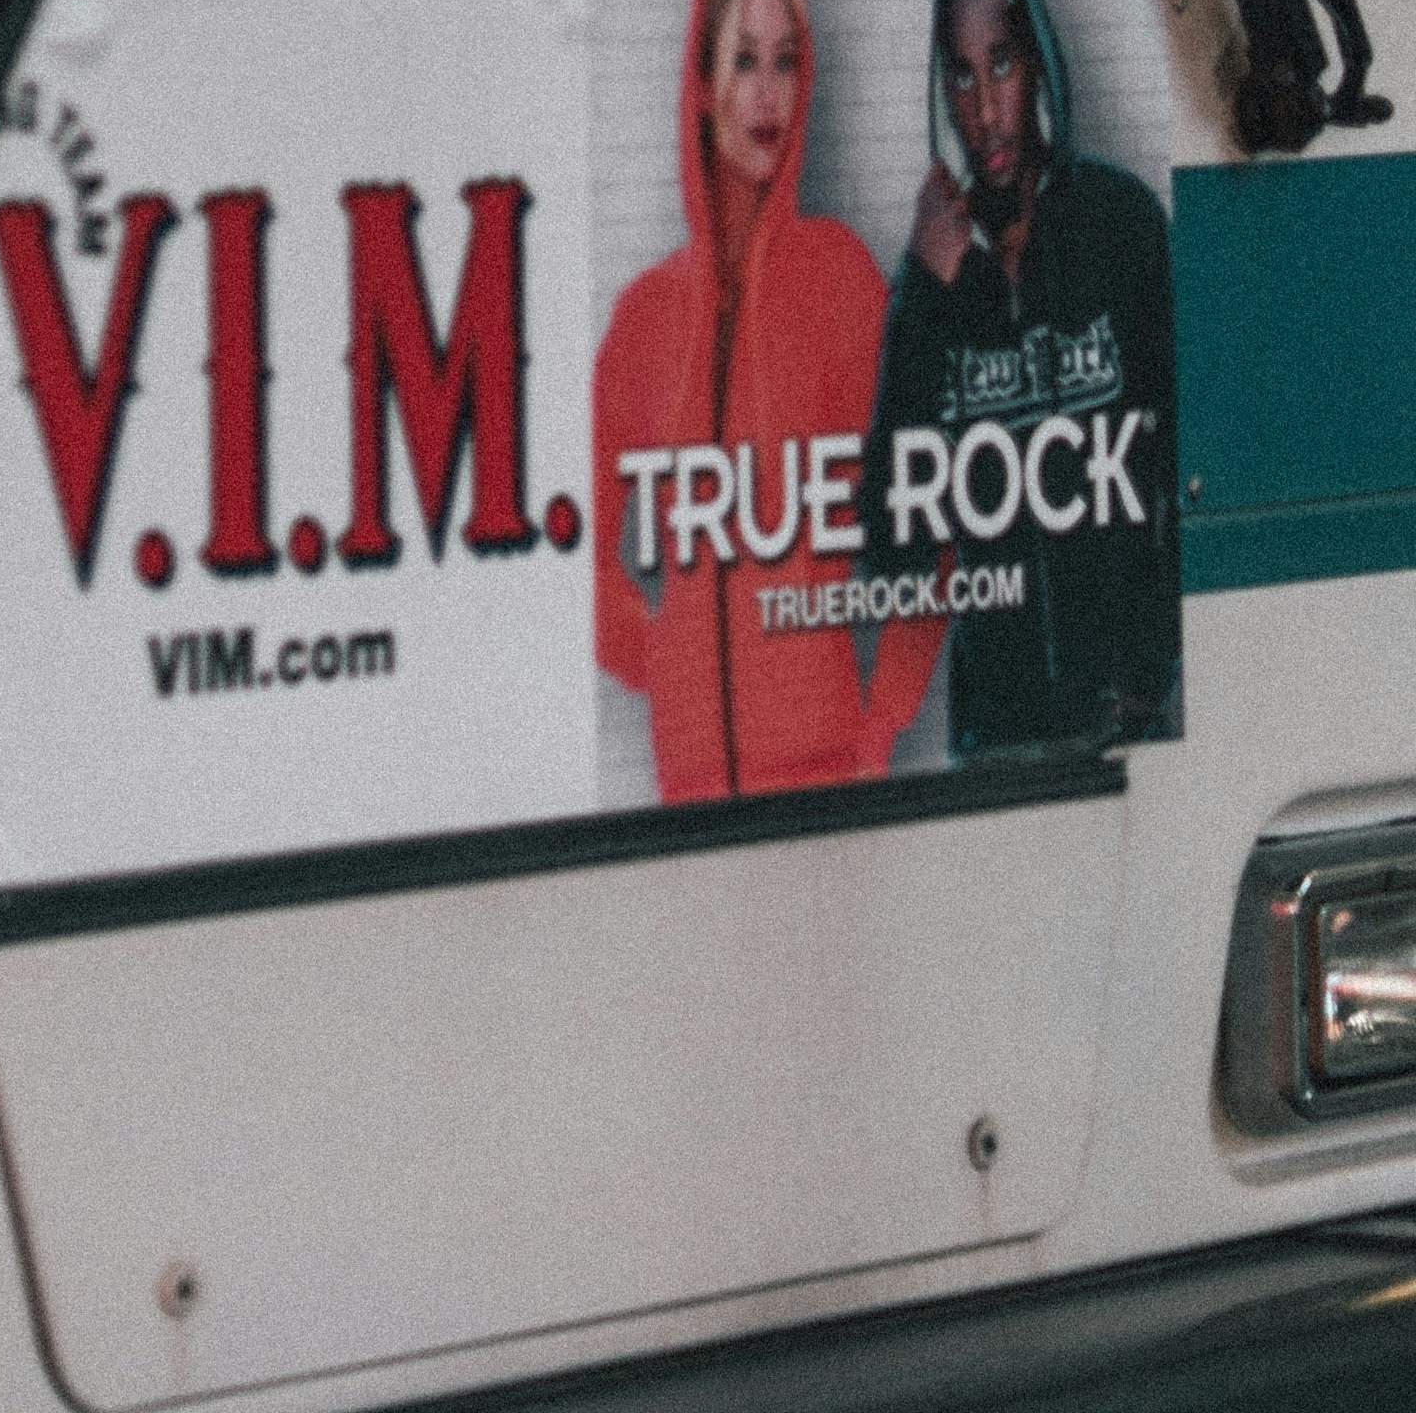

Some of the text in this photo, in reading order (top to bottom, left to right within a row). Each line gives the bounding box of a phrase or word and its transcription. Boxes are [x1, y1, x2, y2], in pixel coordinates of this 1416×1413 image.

[618, 410, 1147, 567] TRUE ROCK
[756, 563, 1025, 633] TRUEROCK.COM
[146, 625, 397, 700] VIM.com
